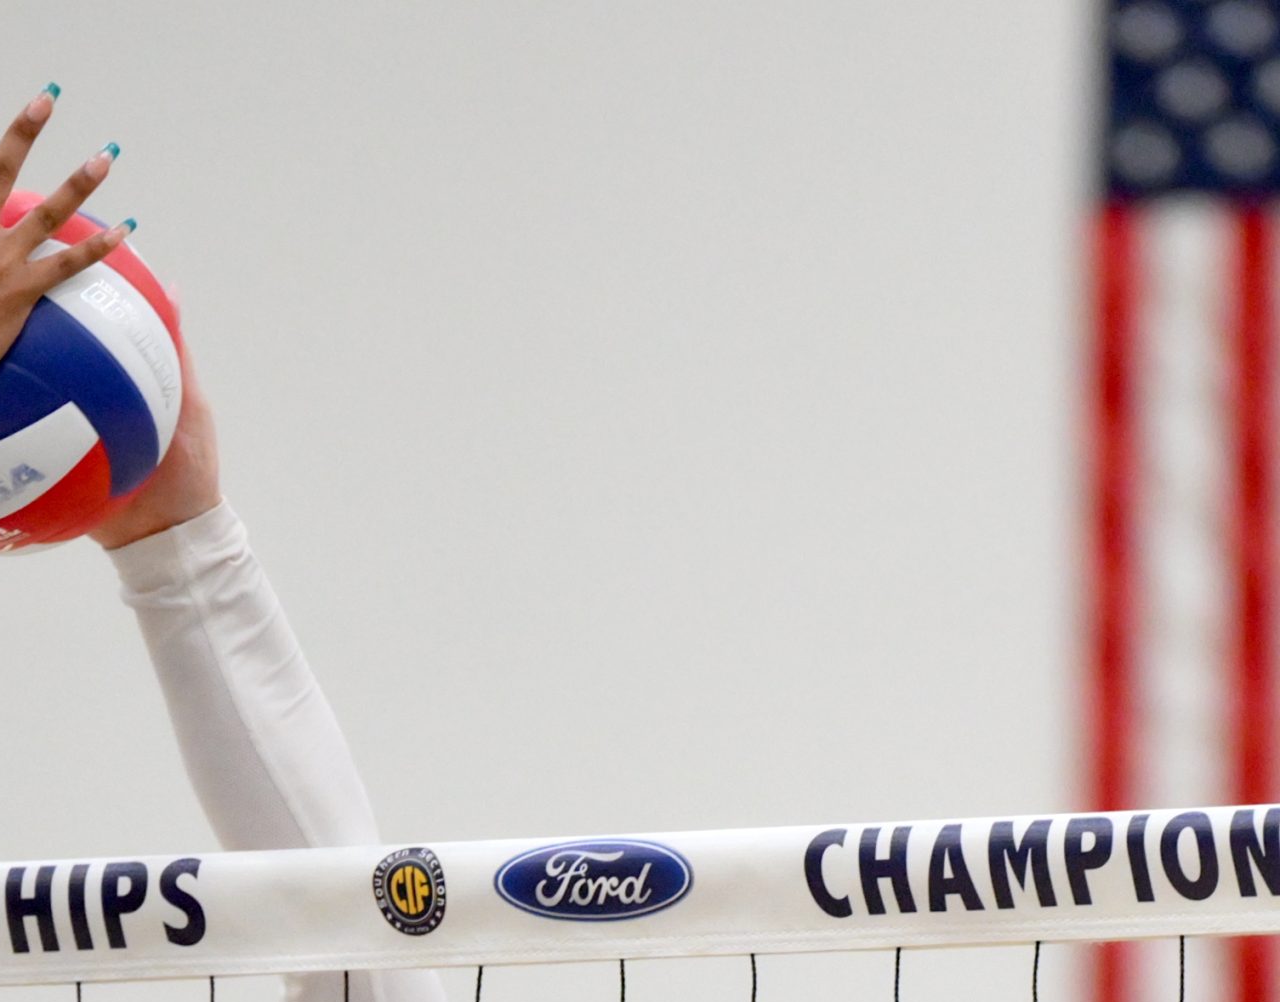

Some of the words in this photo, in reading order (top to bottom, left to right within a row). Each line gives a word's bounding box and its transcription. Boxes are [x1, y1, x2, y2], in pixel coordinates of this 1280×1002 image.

[391, 865, 429, 915] CIF
[535, 850, 652, 907] Ford
[803, 808, 1280, 918] CHAMPION
